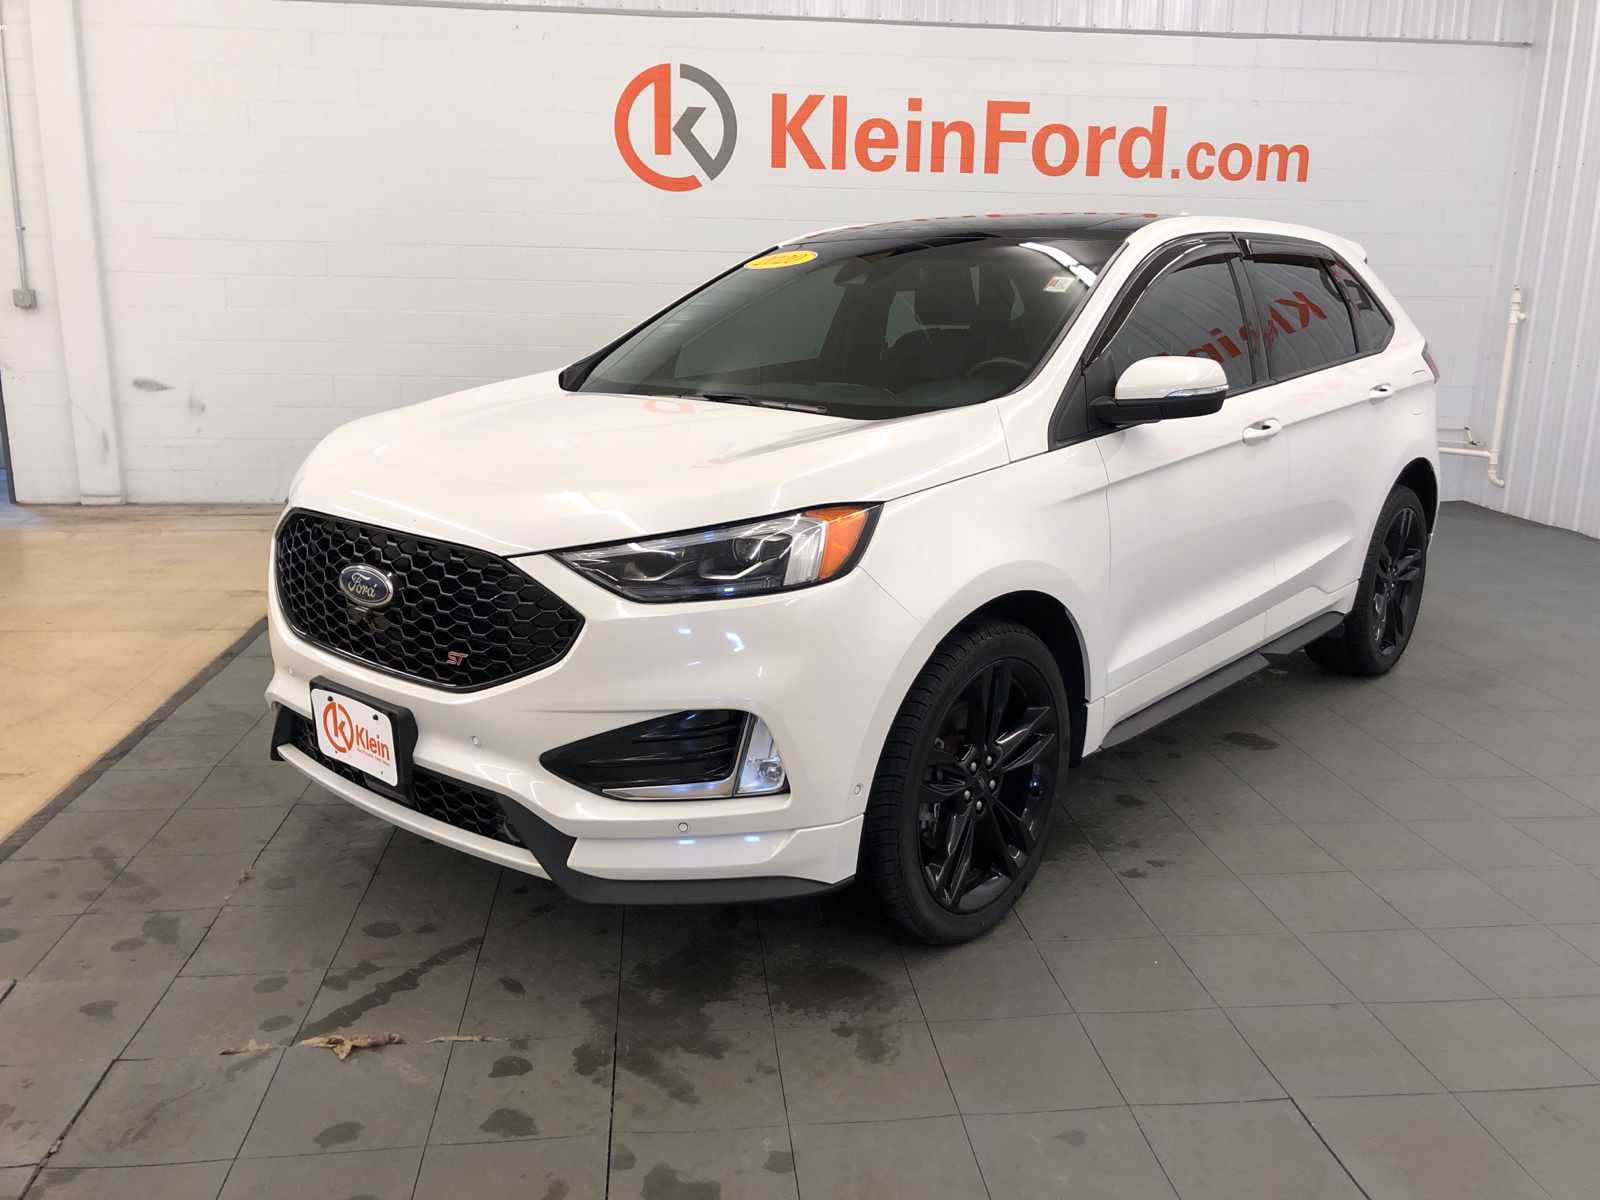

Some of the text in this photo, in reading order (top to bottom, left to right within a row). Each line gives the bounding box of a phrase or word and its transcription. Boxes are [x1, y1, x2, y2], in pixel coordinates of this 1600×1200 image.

[771, 93, 1309, 182] KleinFord.com
[348, 572, 378, 598] Ford
[446, 651, 469, 665] ST
[355, 724, 390, 761] Klein
